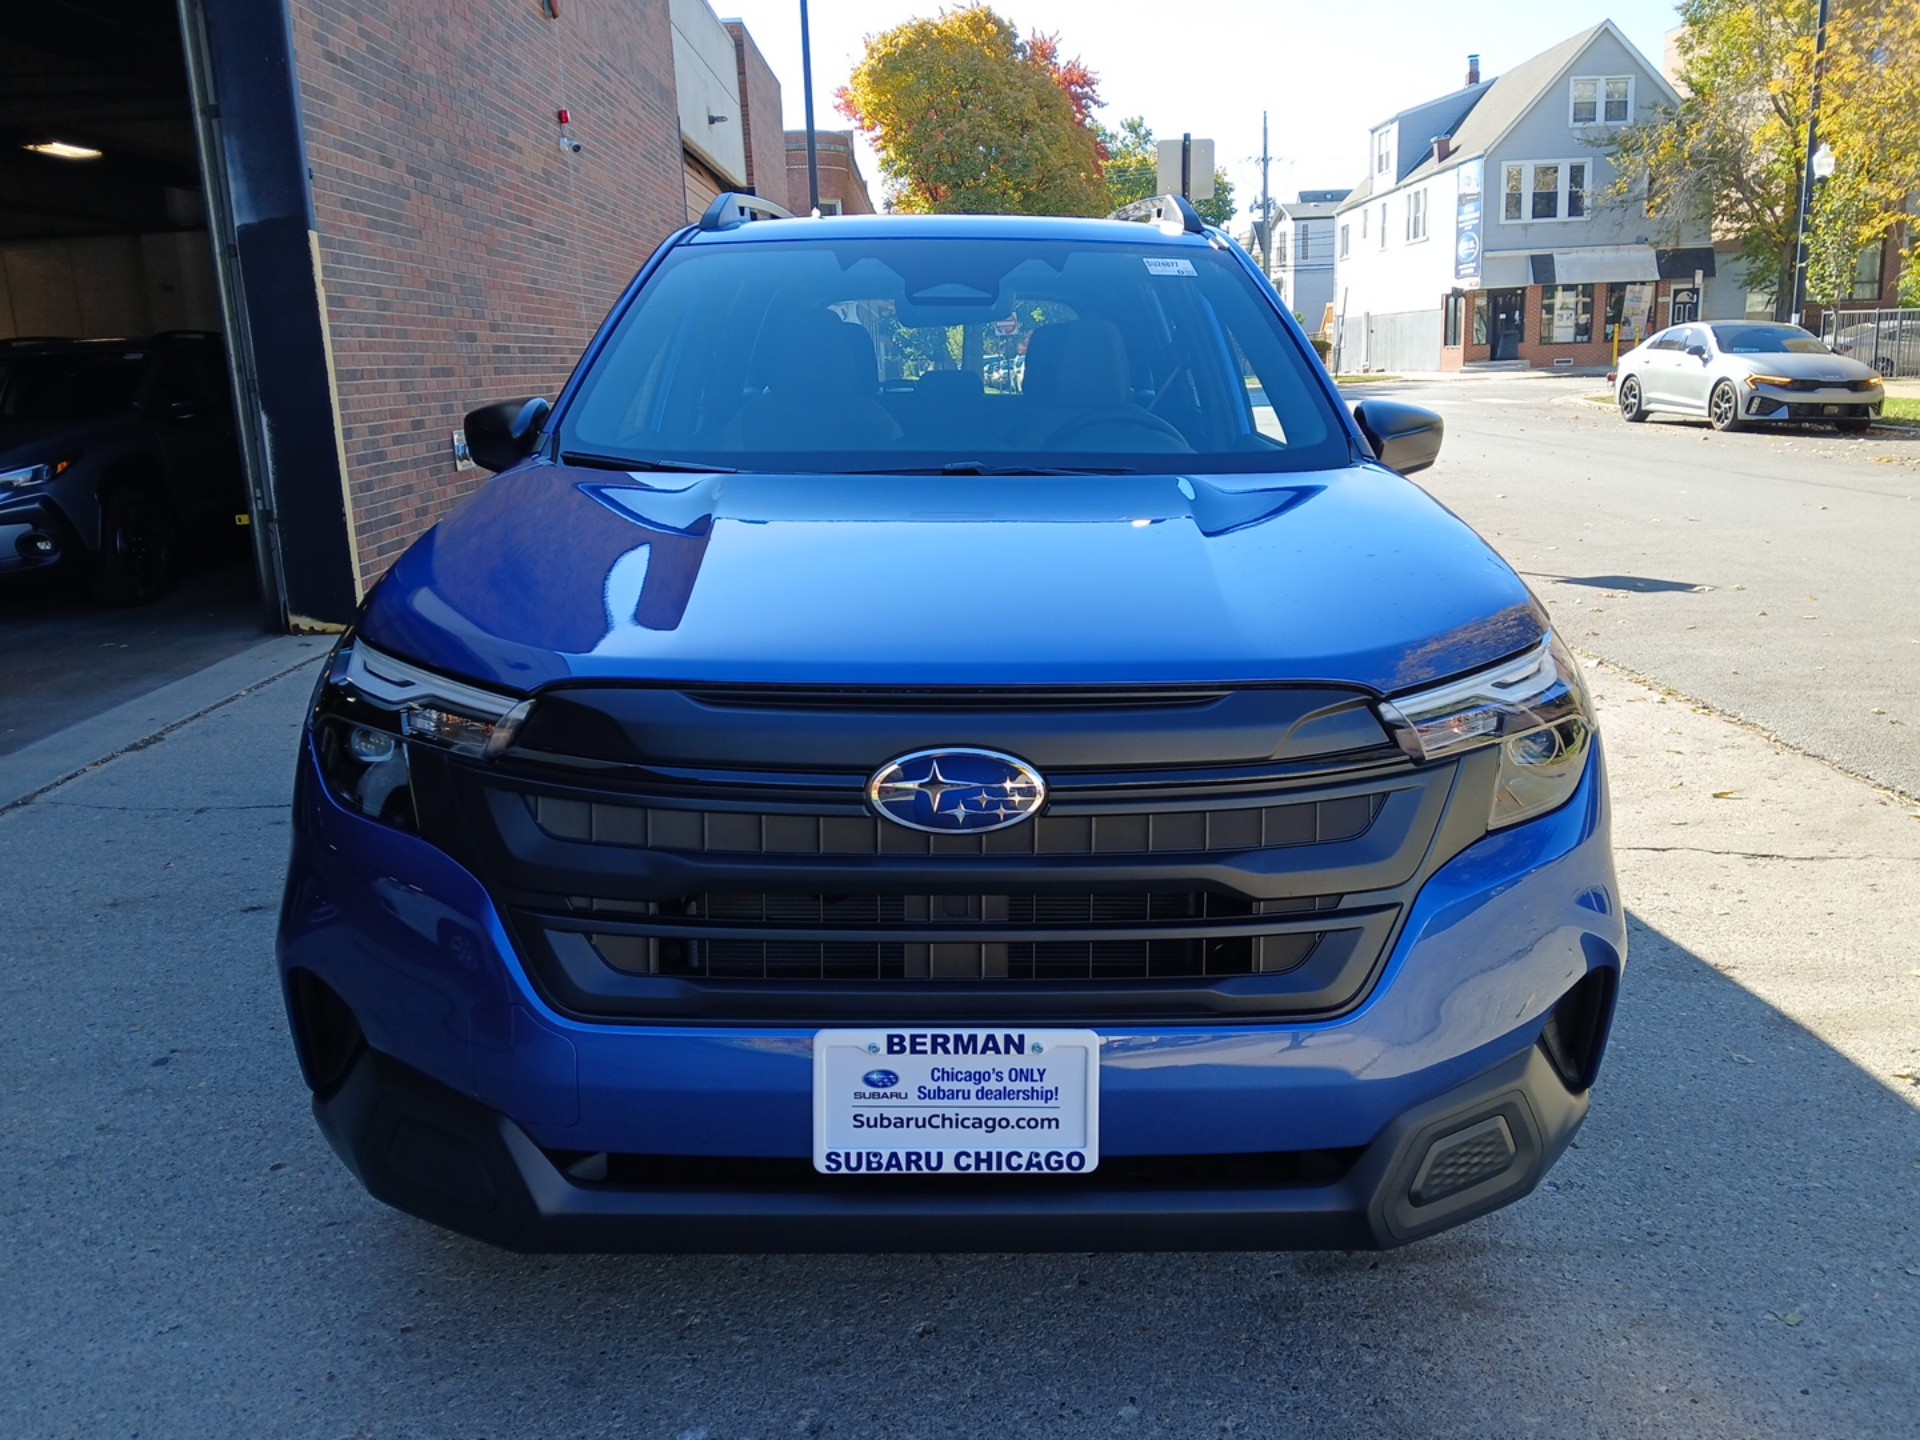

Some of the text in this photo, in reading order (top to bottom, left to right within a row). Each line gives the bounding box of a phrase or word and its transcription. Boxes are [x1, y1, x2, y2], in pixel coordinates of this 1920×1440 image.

[886, 1033, 1025, 1055] BERMAN
[931, 1067, 1047, 1084] Chicago's ONLY
[853, 1092, 908, 1100] SUBARU
[917, 1086, 1059, 1104] Subaru dealership!
[852, 1113, 1060, 1133] SubaruChicago.com
[825, 1151, 1086, 1172] SUBARU CHICAGO
